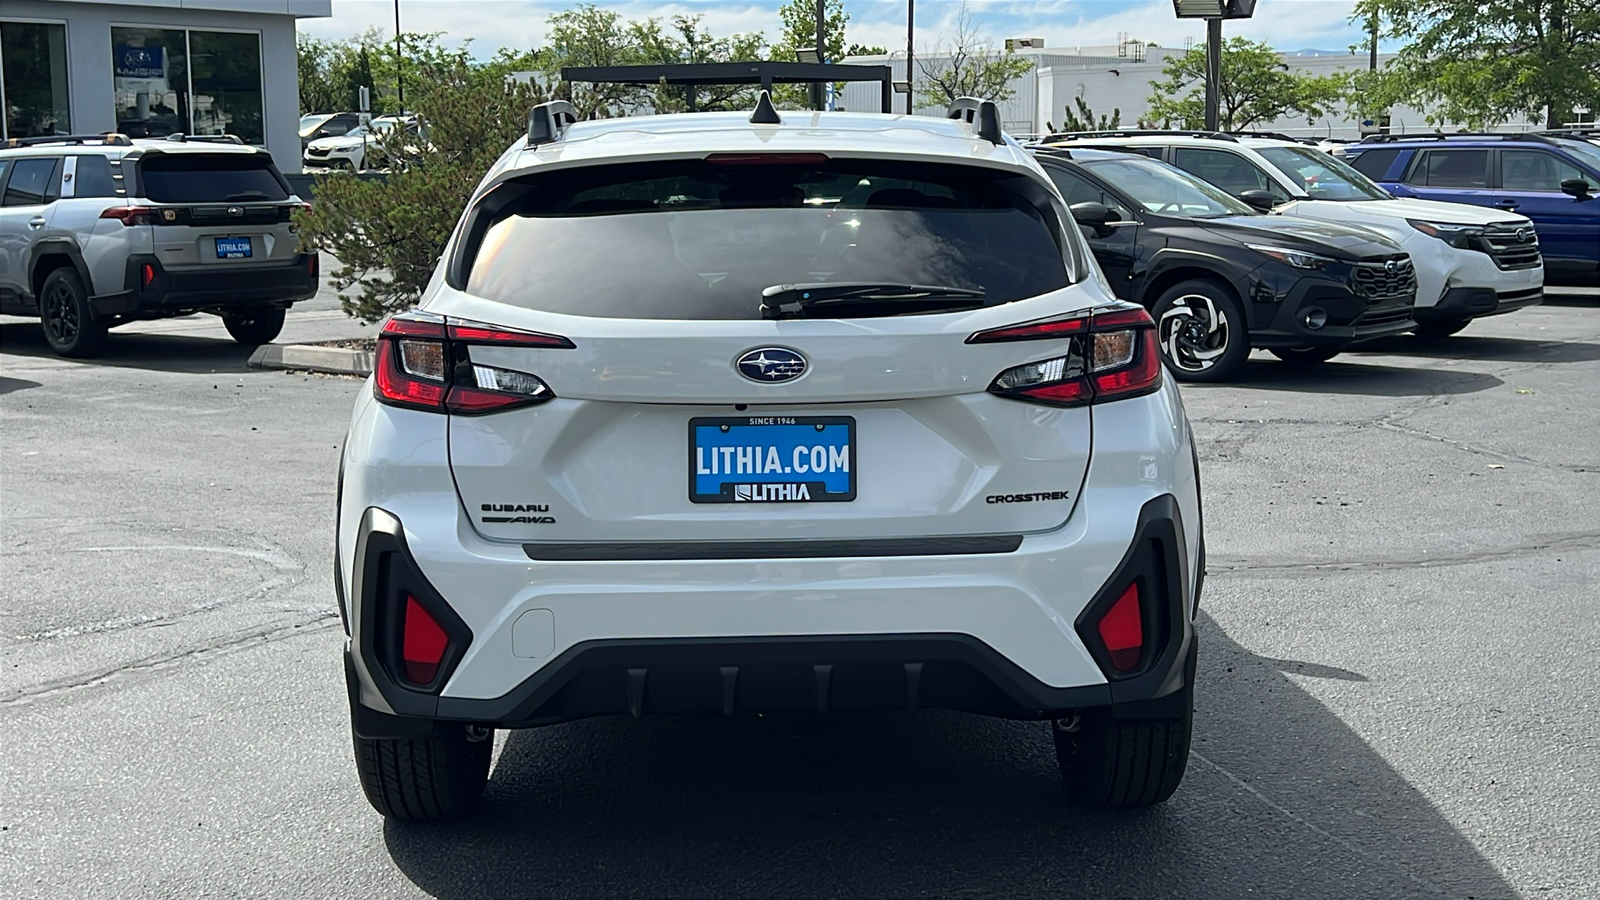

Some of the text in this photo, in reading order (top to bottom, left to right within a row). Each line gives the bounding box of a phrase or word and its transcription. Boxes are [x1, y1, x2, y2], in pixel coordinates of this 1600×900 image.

[217, 243, 251, 252] LITHIA.COM
[749, 417, 796, 425] SINCE 1946
[696, 445, 849, 475] LITHIA.COM
[752, 483, 811, 501] LITHIA
[985, 490, 1069, 504] CROSSTREK
[481, 503, 549, 513] SUBARU
[509, 516, 556, 524] AWD
